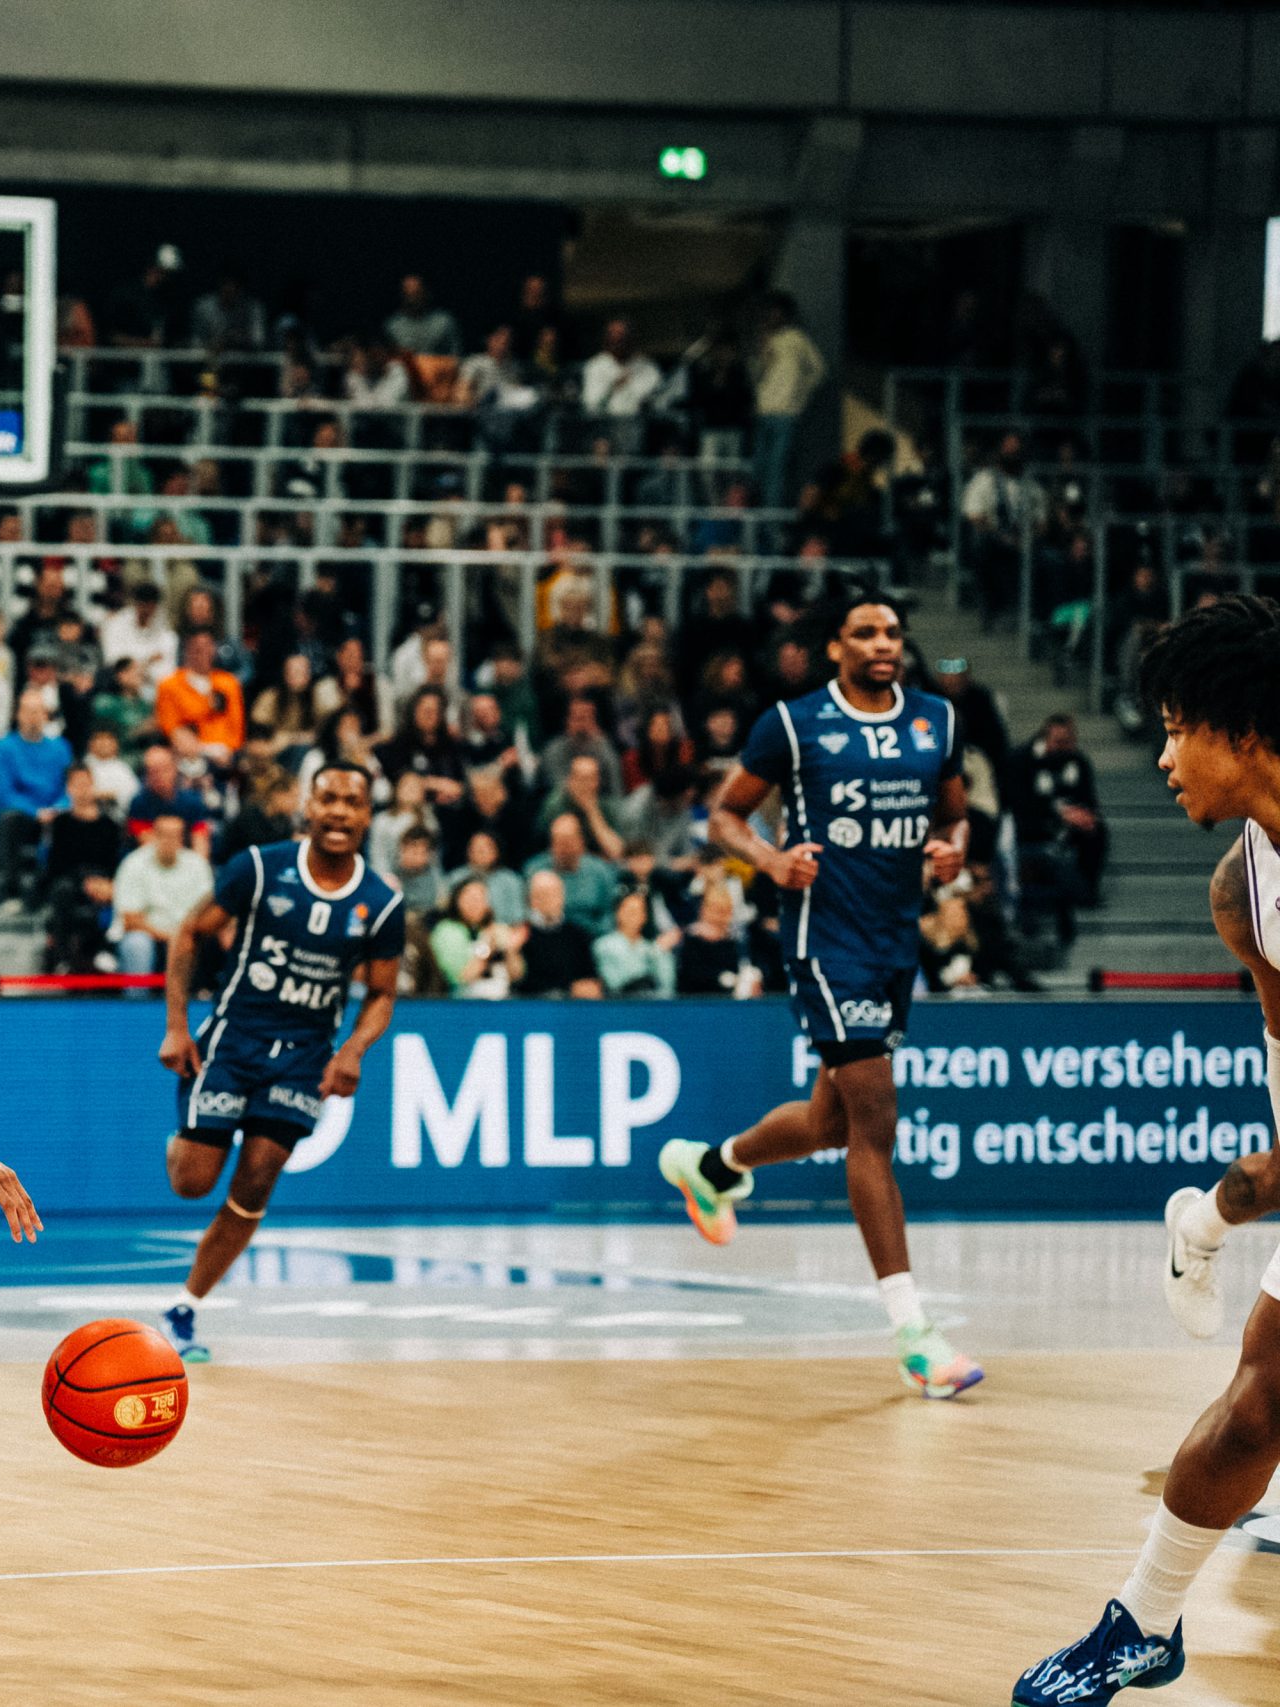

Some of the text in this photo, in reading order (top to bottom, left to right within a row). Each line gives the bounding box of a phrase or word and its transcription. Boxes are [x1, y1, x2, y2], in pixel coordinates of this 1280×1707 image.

[860, 726, 901, 759] 12
[307, 901, 332, 935] 0
[792, 1035, 1010, 1088] Fnzen
[391, 1032, 681, 1168] MLP
[973, 1106, 1270, 1163] entscheiden
